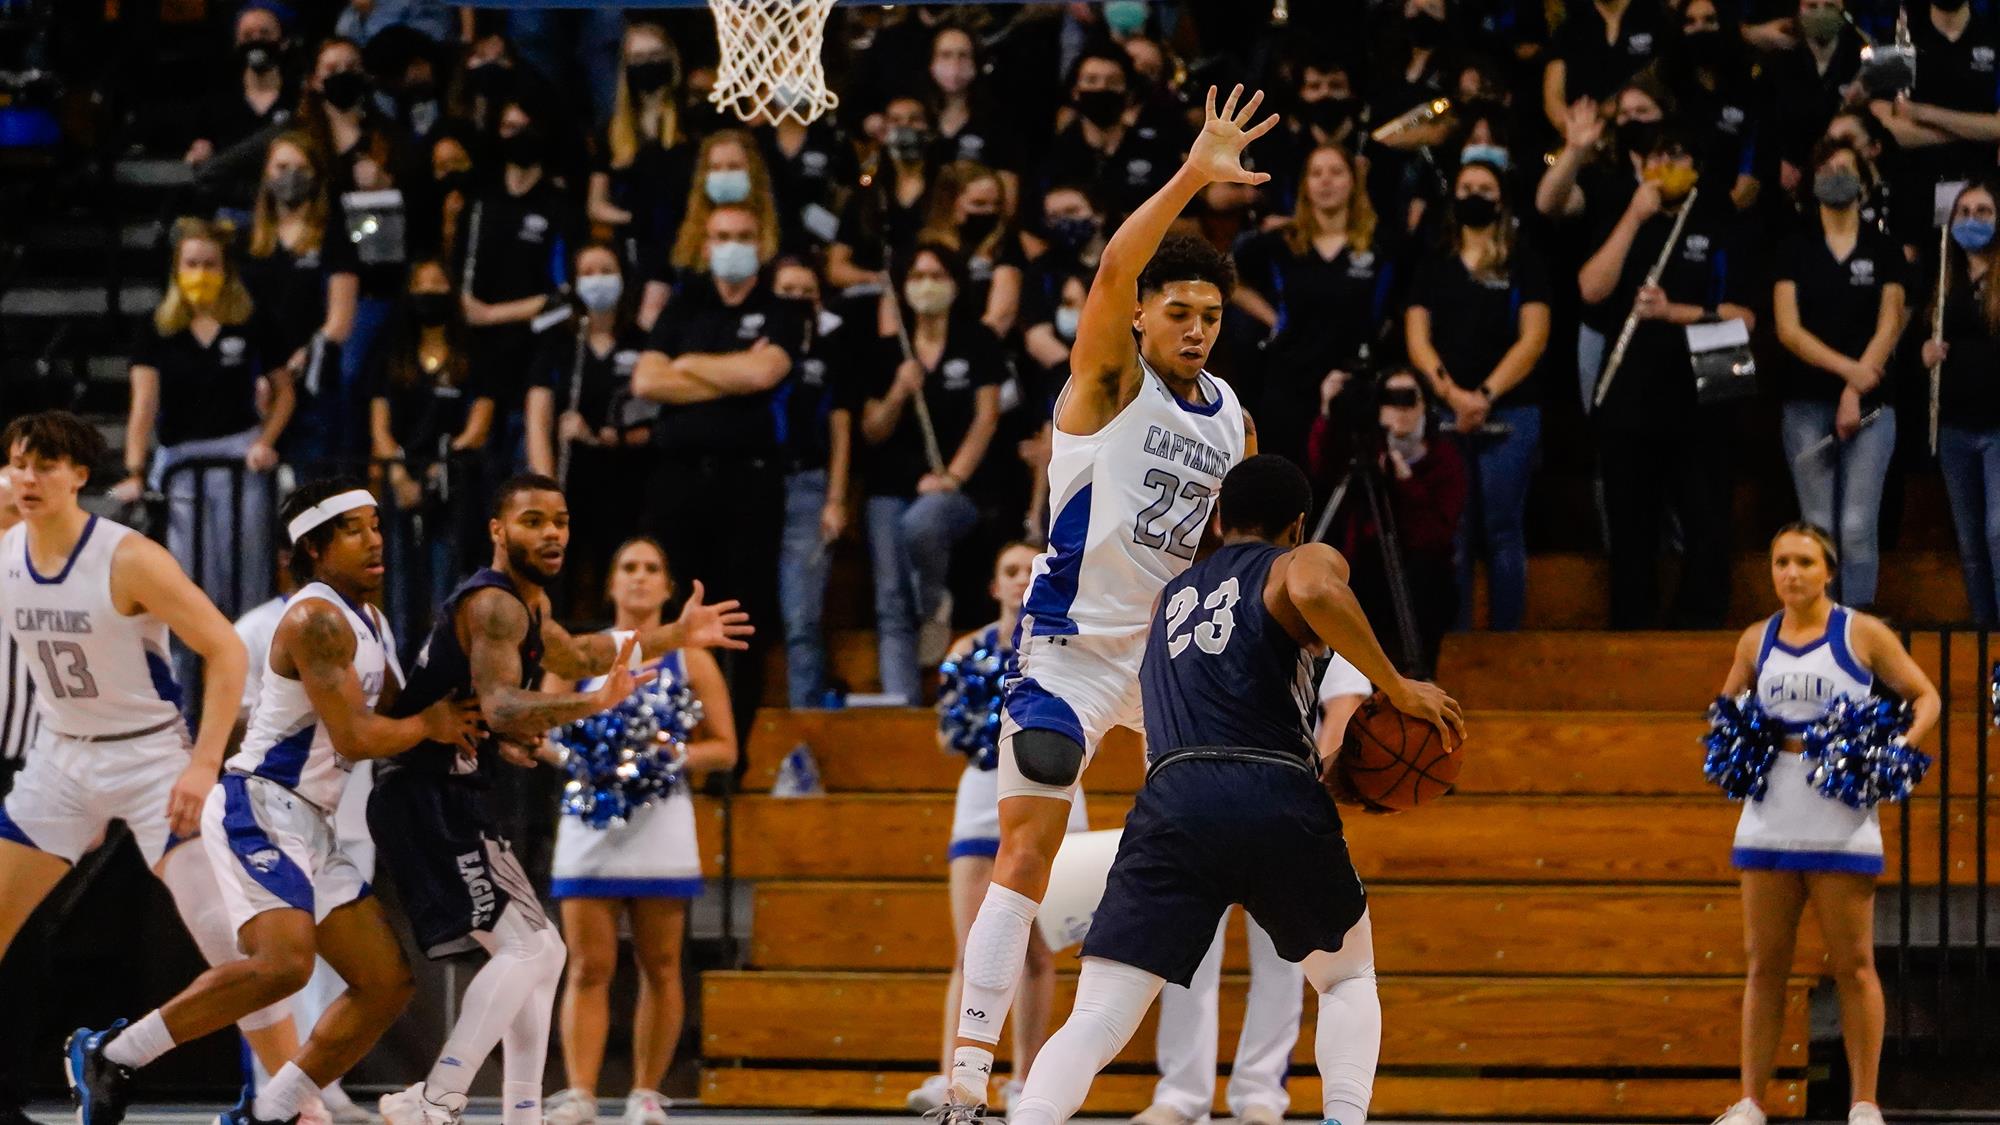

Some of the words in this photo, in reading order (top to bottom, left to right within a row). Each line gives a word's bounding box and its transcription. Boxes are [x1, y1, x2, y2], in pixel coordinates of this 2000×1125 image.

[1143, 425, 1231, 480] CAPTAINS
[1133, 468, 1211, 561] 22
[15, 607, 92, 634] CAPTAINS
[1165, 577, 1241, 659] 23
[37, 640, 99, 698] 13
[1763, 672, 1835, 709] CNU
